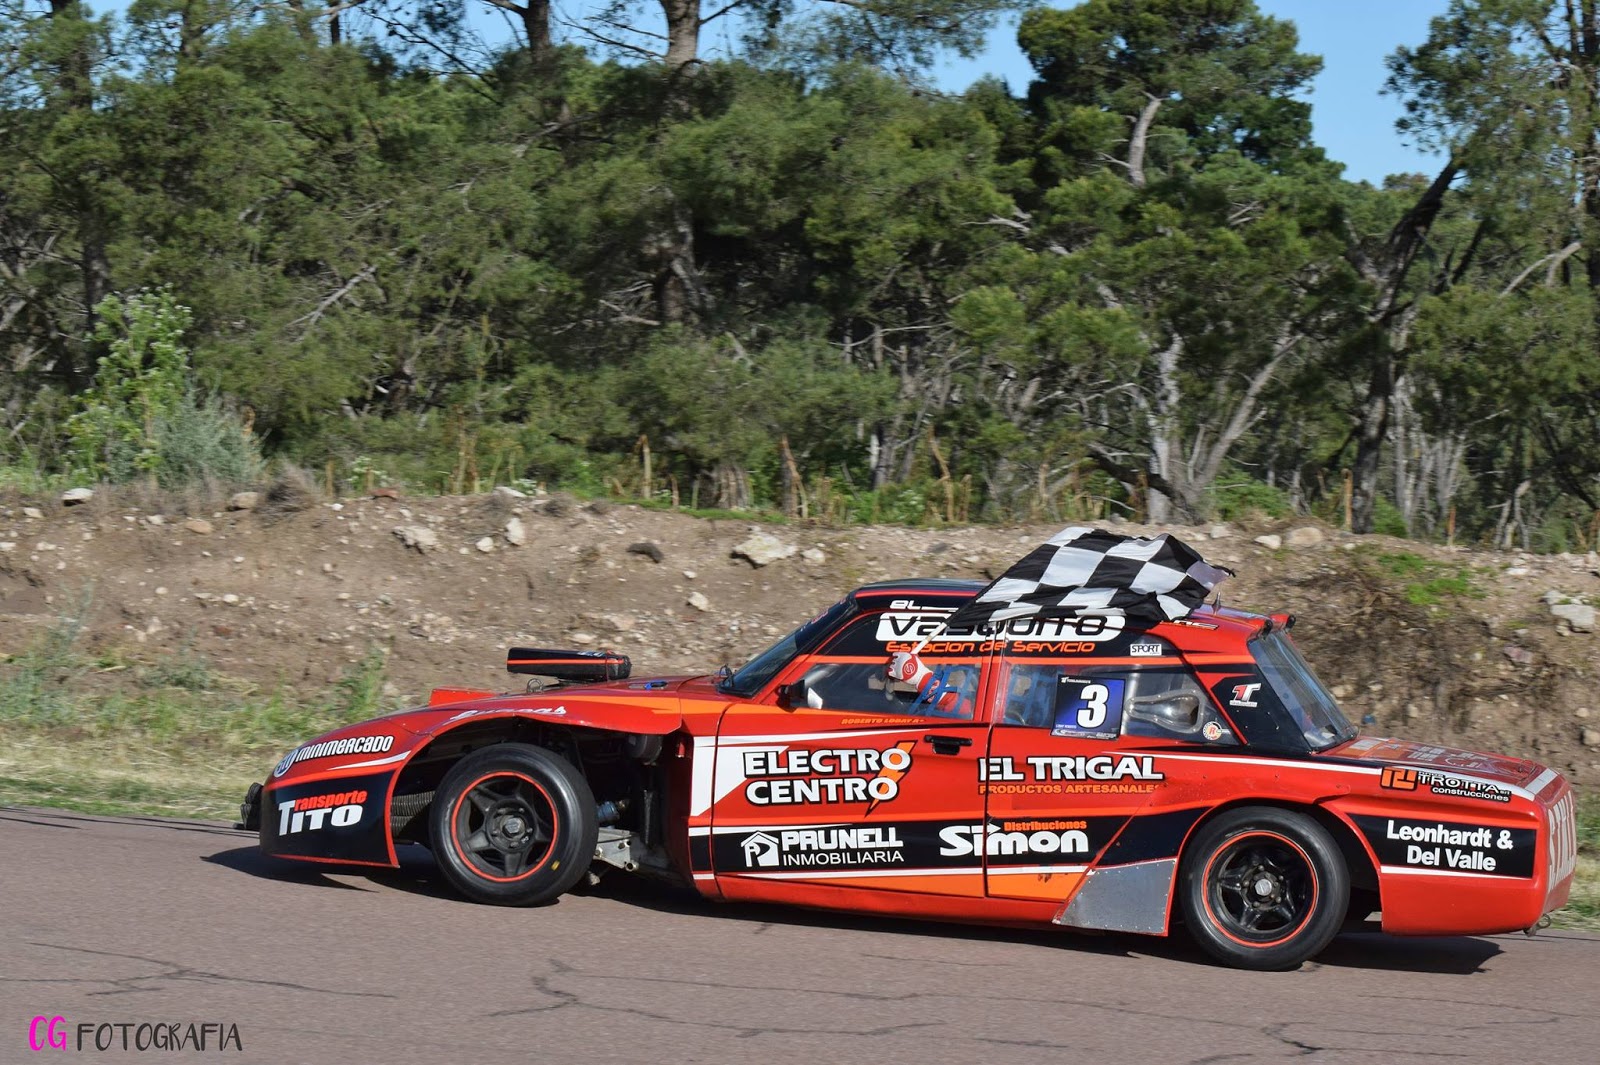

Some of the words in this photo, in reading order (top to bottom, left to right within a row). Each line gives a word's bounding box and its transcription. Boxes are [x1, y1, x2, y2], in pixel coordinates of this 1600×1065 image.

[979, 640, 1008, 652] de
[1012, 640, 1096, 653] Servicio
[1131, 644, 1160, 653] SPORT
[1077, 683, 1109, 728] 3
[749, 748, 912, 776] ELECTRO
[979, 756, 1024, 782] EL
[1027, 756, 1164, 781] TRIGAL
[746, 776, 899, 805] CENTRO
[979, 784, 1062, 795] PRODUCTOS
[1417, 775, 1500, 794] TROTTA
[1431, 787, 1510, 802] construcciones
[1003, 820, 1088, 832] Distribuciones
[1386, 820, 1492, 848] Leonhardt
[1496, 829, 1514, 850] &
[781, 827, 904, 851] PRUNELL
[782, 850, 905, 866] INMOBILIARIA
[1406, 845, 1440, 866] Del
[1444, 848, 1497, 872] Valle
